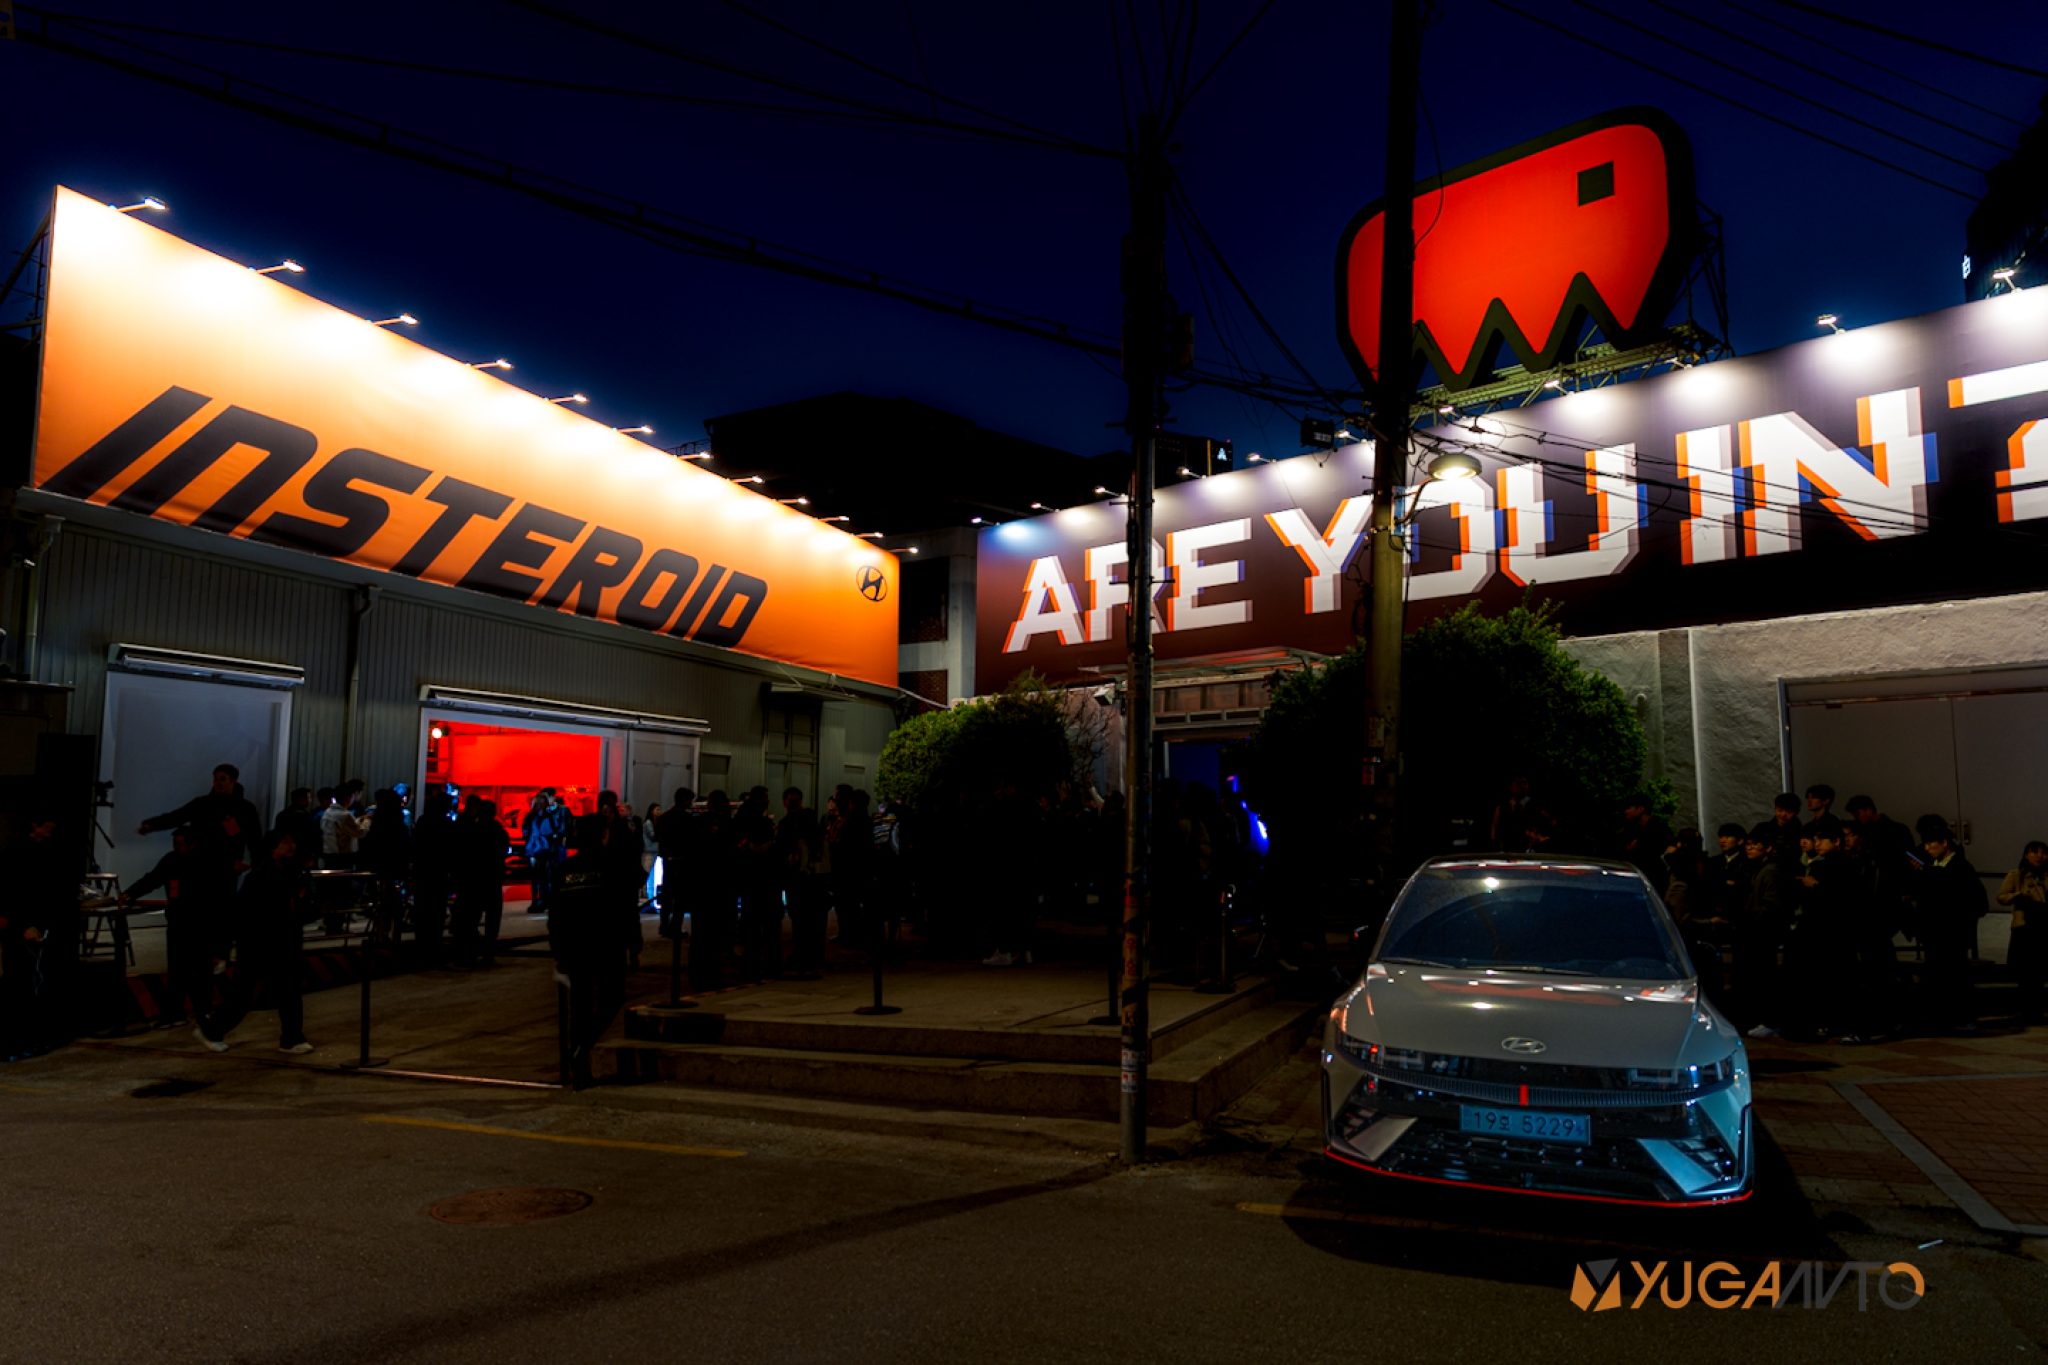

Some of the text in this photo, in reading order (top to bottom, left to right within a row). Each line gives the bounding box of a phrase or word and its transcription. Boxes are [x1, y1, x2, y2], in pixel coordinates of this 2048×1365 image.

[40, 385, 767, 648] INSTEROID
[1002, 518, 1255, 656] ARE
[1264, 443, 1640, 618] YOU
[1522, 1115, 1574, 1137] 5229
